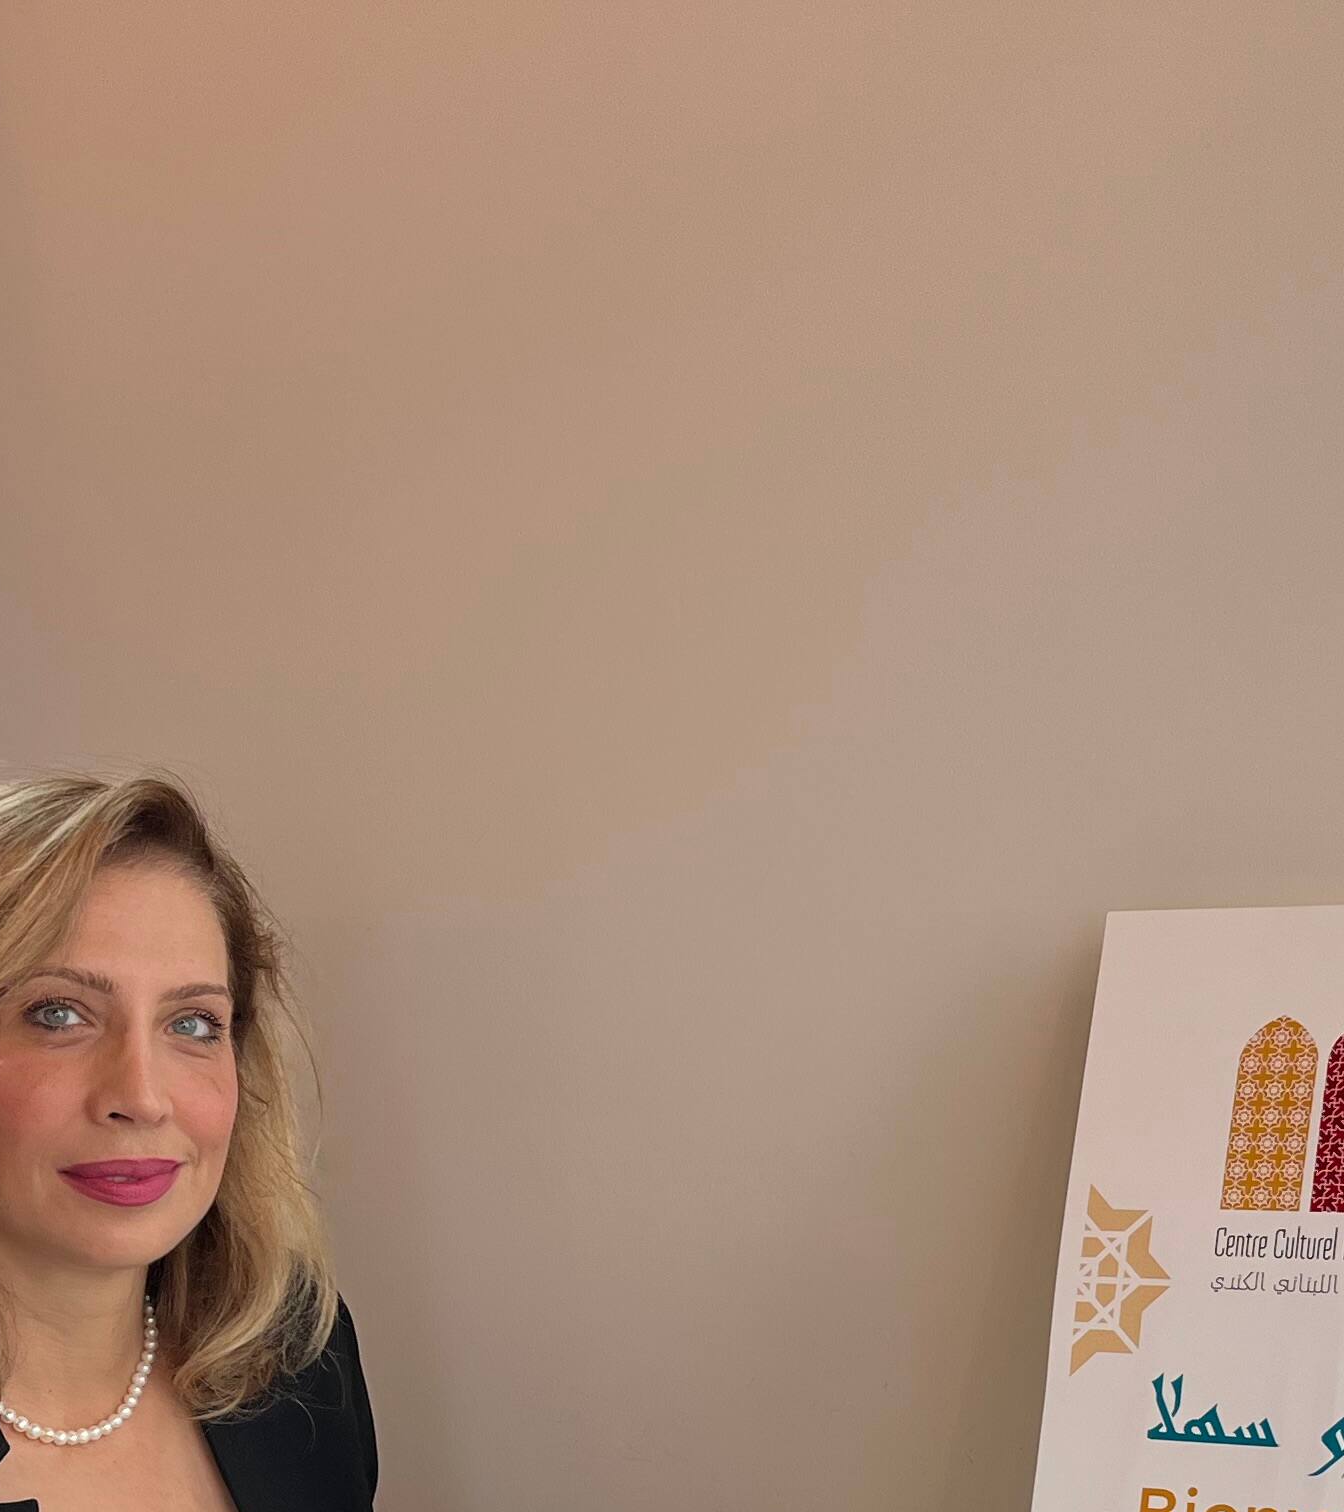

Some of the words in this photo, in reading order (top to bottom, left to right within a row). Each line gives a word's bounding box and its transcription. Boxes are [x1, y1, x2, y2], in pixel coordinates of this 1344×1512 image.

[1214, 1227, 1268, 1258] Centre
[1273, 1226, 1338, 1261] Culturel
[1210, 1272, 1265, 1293] الكندي
[1273, 1273, 1338, 1297] اللبناني
[1147, 1372, 1280, 1447] سهلا
